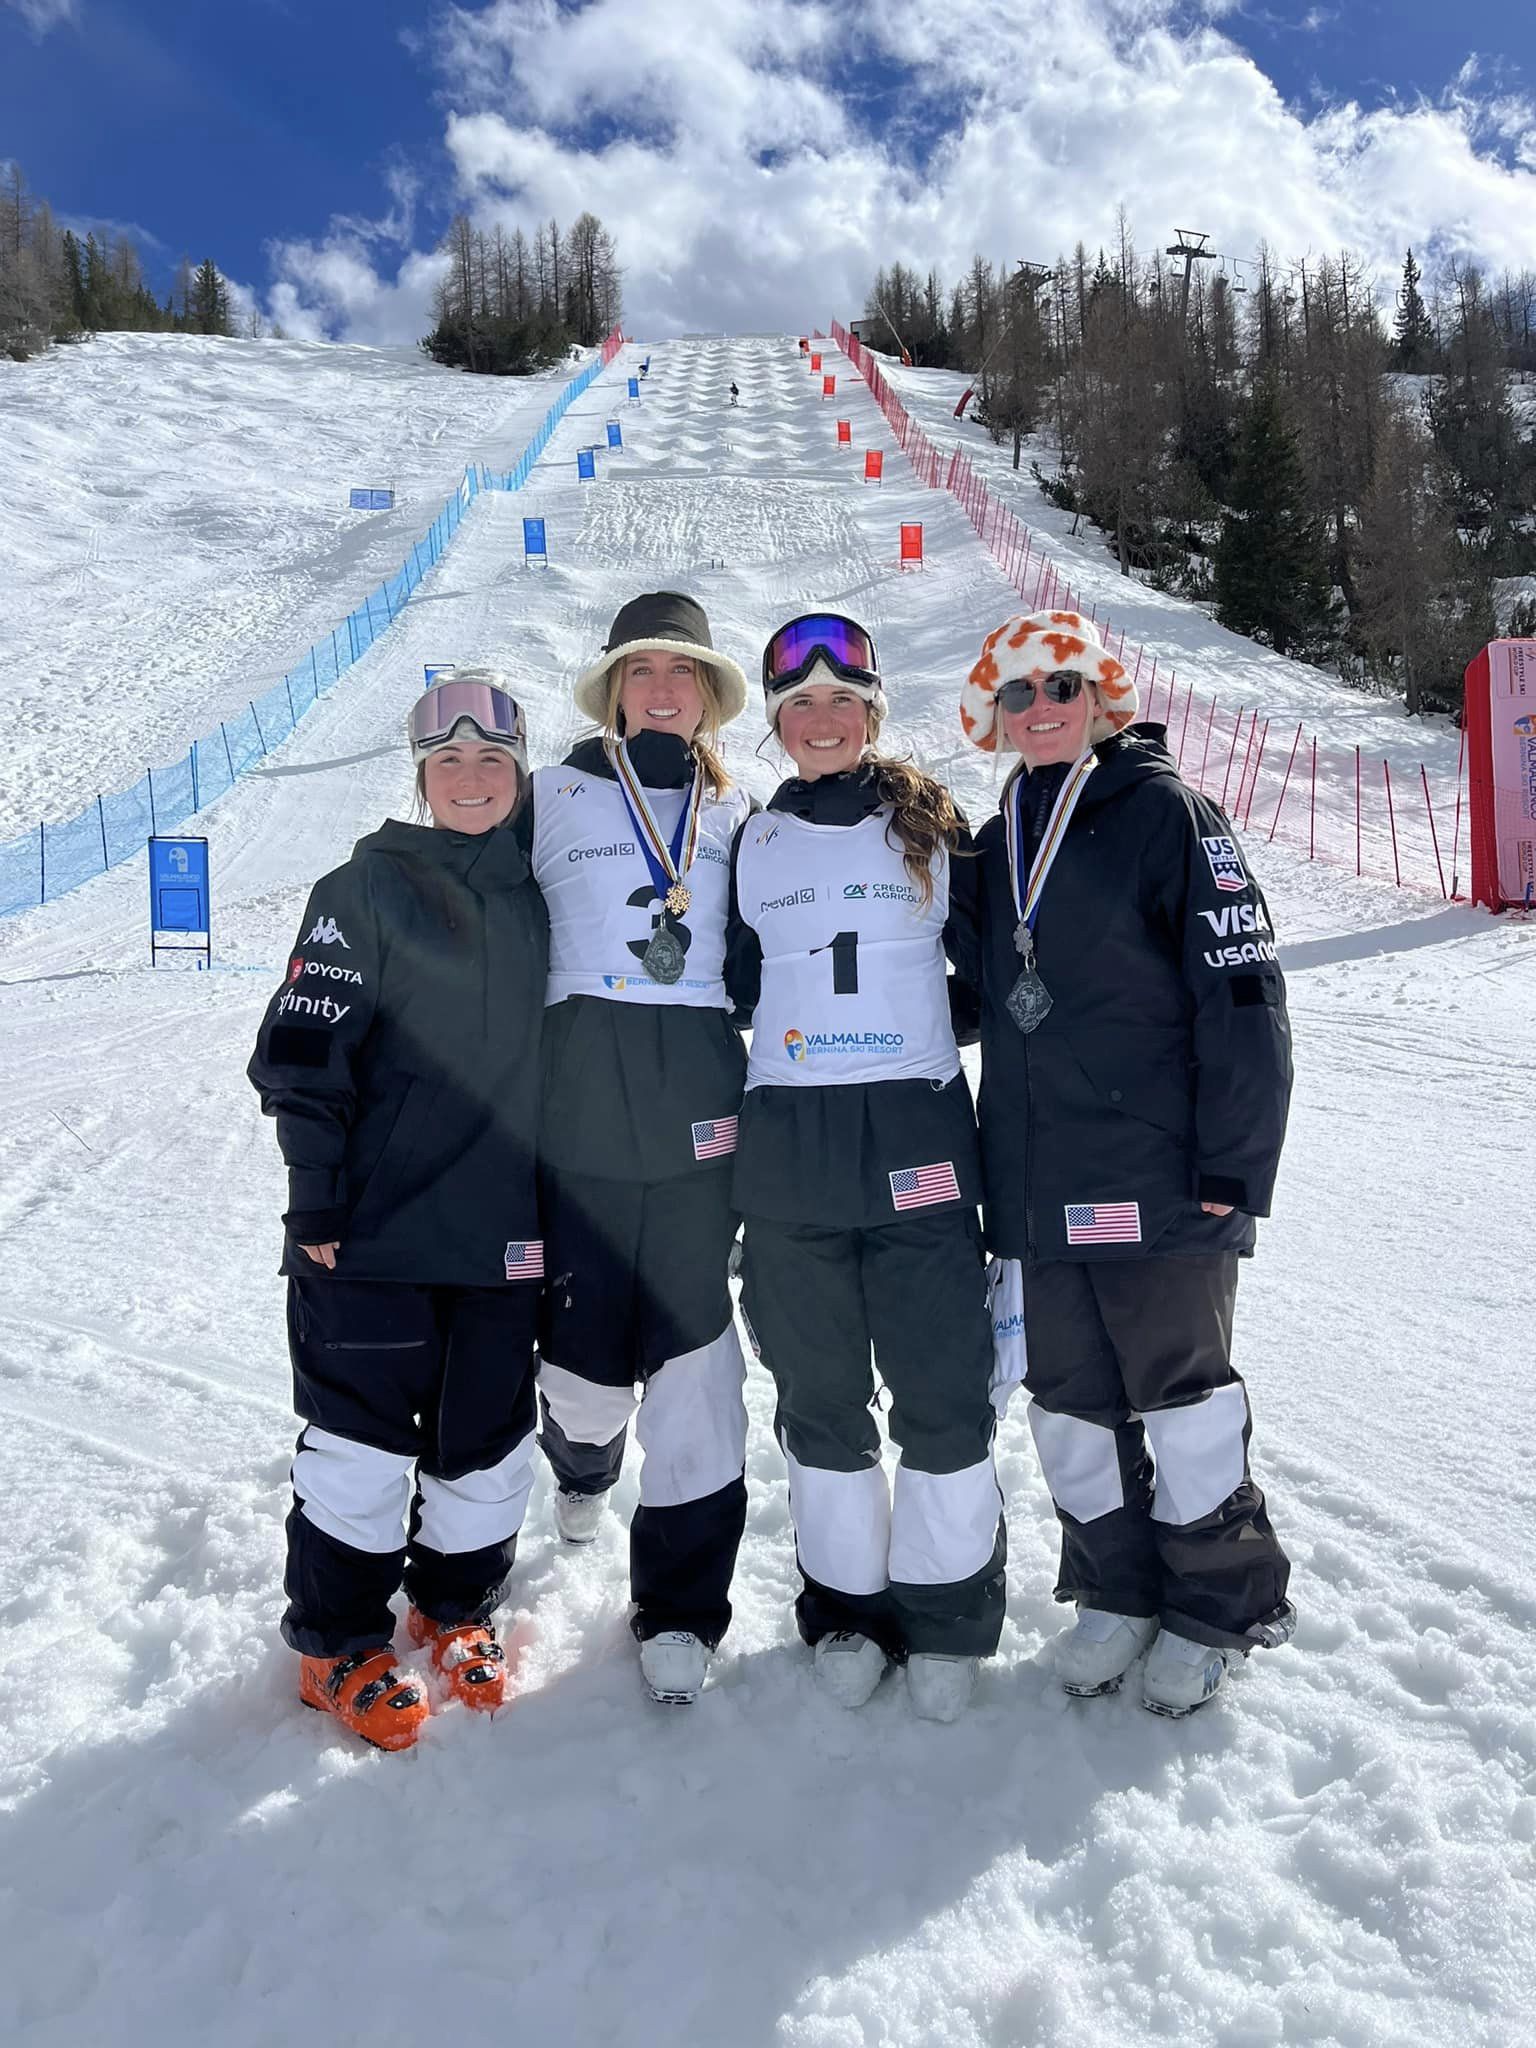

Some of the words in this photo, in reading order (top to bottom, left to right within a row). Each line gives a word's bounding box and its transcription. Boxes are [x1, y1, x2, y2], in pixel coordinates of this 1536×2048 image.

[568, 844, 618, 862] Creval
[1204, 839, 1235, 856] US
[873, 891, 921, 903] AGRICOL
[626, 885, 692, 961] 3
[1197, 904, 1270, 937] VISA
[809, 932, 858, 994] 1
[277, 988, 351, 1024] xfinity
[804, 1033, 904, 1046] VALMALENCO
